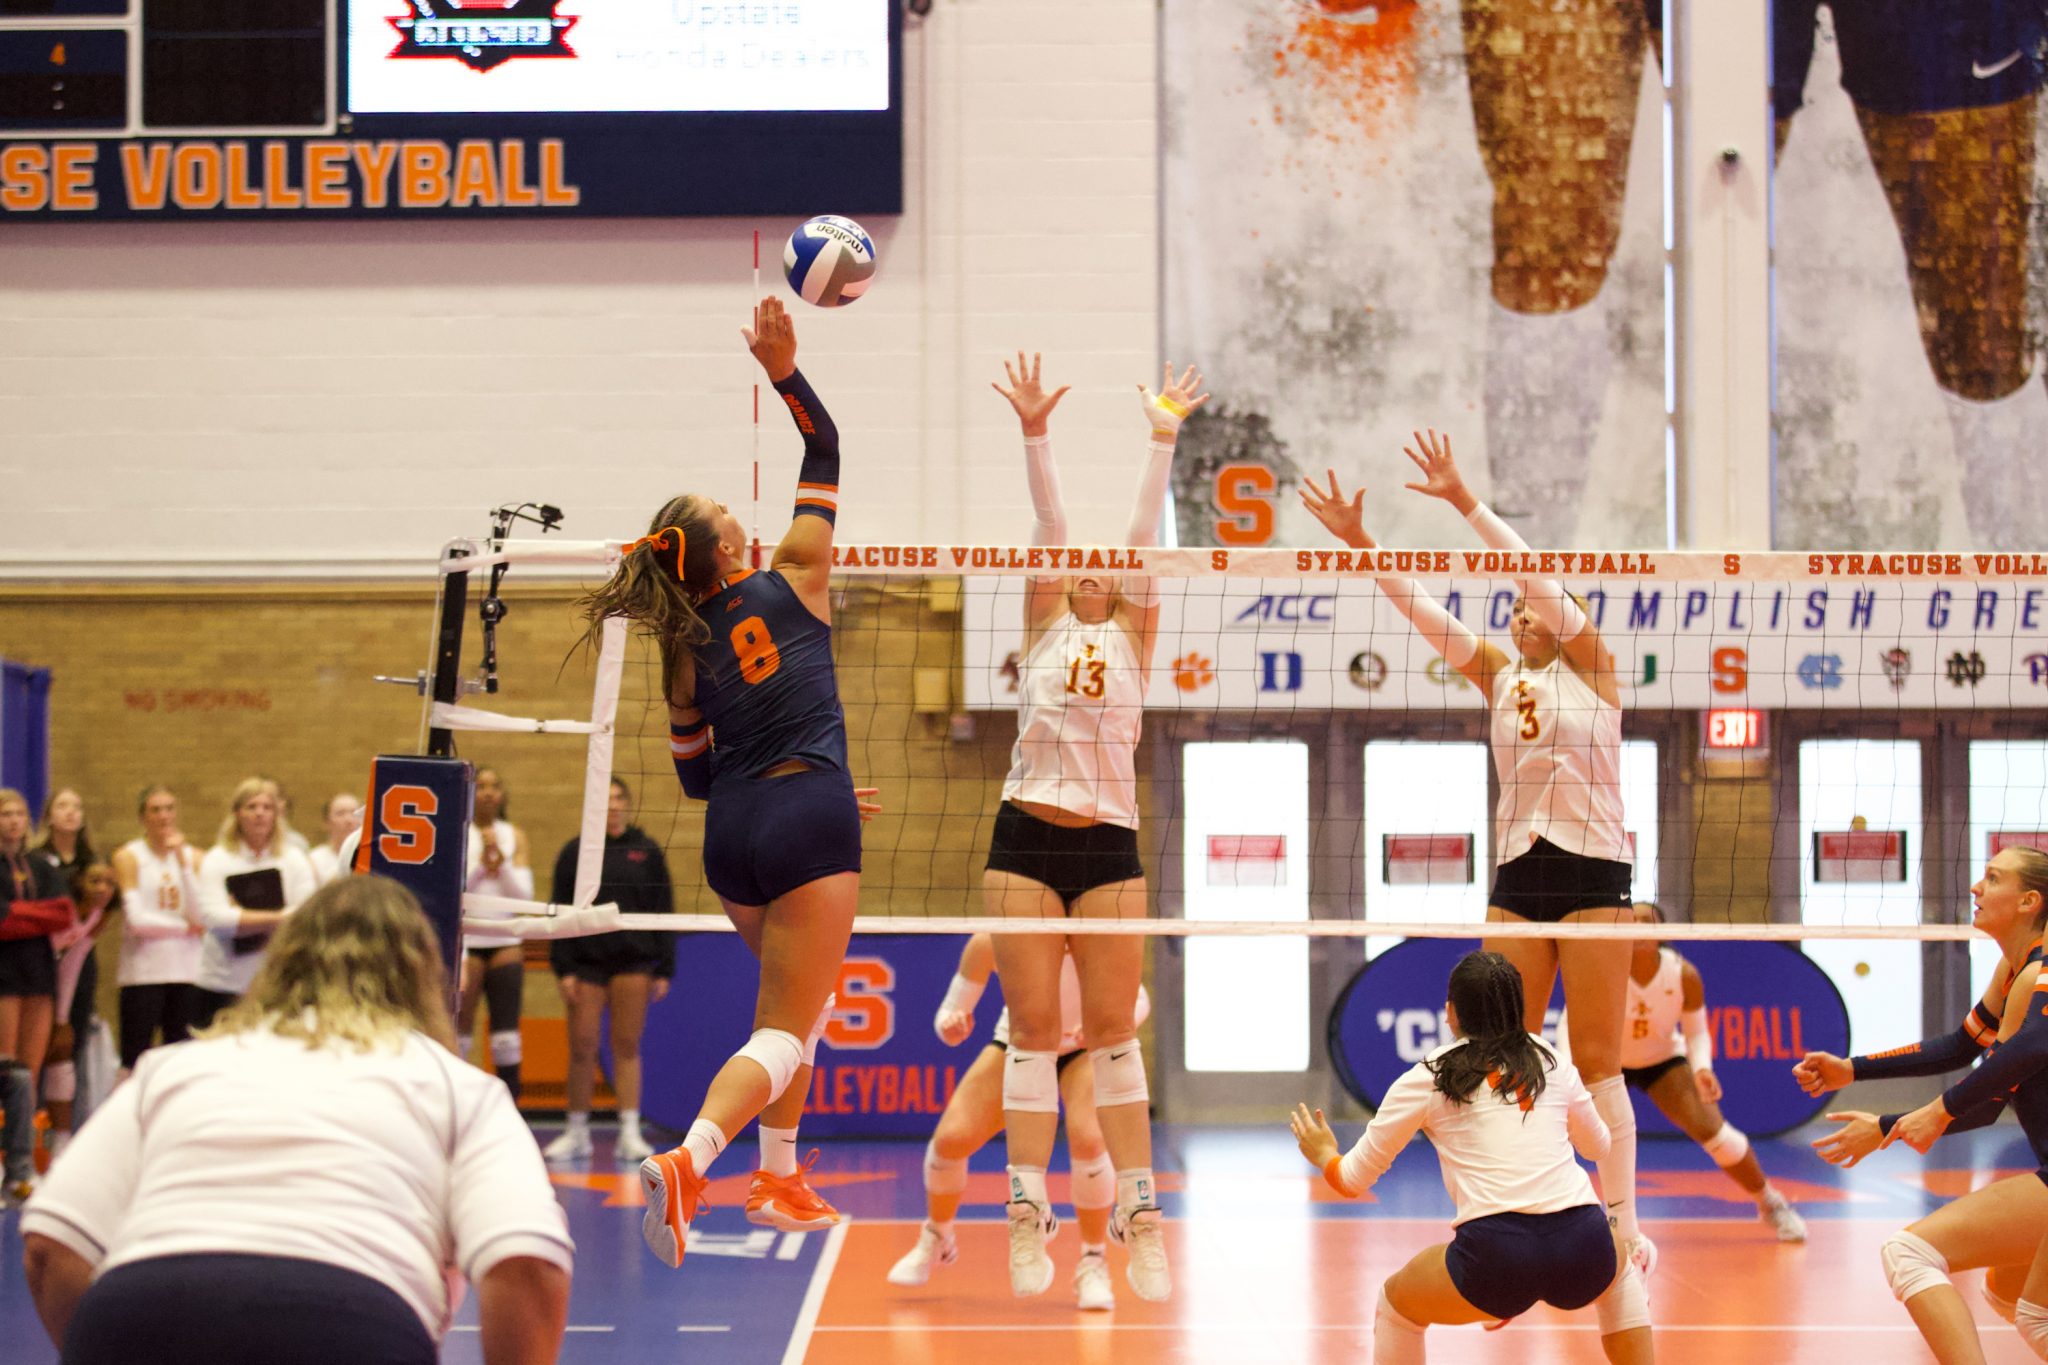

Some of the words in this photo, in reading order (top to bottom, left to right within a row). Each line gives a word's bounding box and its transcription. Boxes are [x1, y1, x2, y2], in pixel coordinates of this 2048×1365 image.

[0, 143, 98, 211] SE
[119, 139, 580, 210] VOLLEYBALL
[816, 224, 863, 253] molten
[1214, 464, 1276, 547] S
[951, 547, 1143, 570] VOLLEYBALL
[1211, 550, 1229, 571] S
[1296, 551, 1450, 572] SYRACUSE
[1463, 552, 1656, 575] VOLLEYBALL
[1723, 554, 1741, 575] S
[1808, 554, 1962, 576] SYRACUSE
[1973, 554, 2048, 575] VOLL
[1234, 594, 1335, 623] ACC
[730, 616, 781, 685] 8
[1066, 656, 1106, 698] 13
[1712, 646, 1748, 695] S
[1516, 699, 1541, 741] 3
[1708, 710, 1761, 747] EXIT
[379, 784, 438, 865] S
[820, 956, 895, 1050] S
